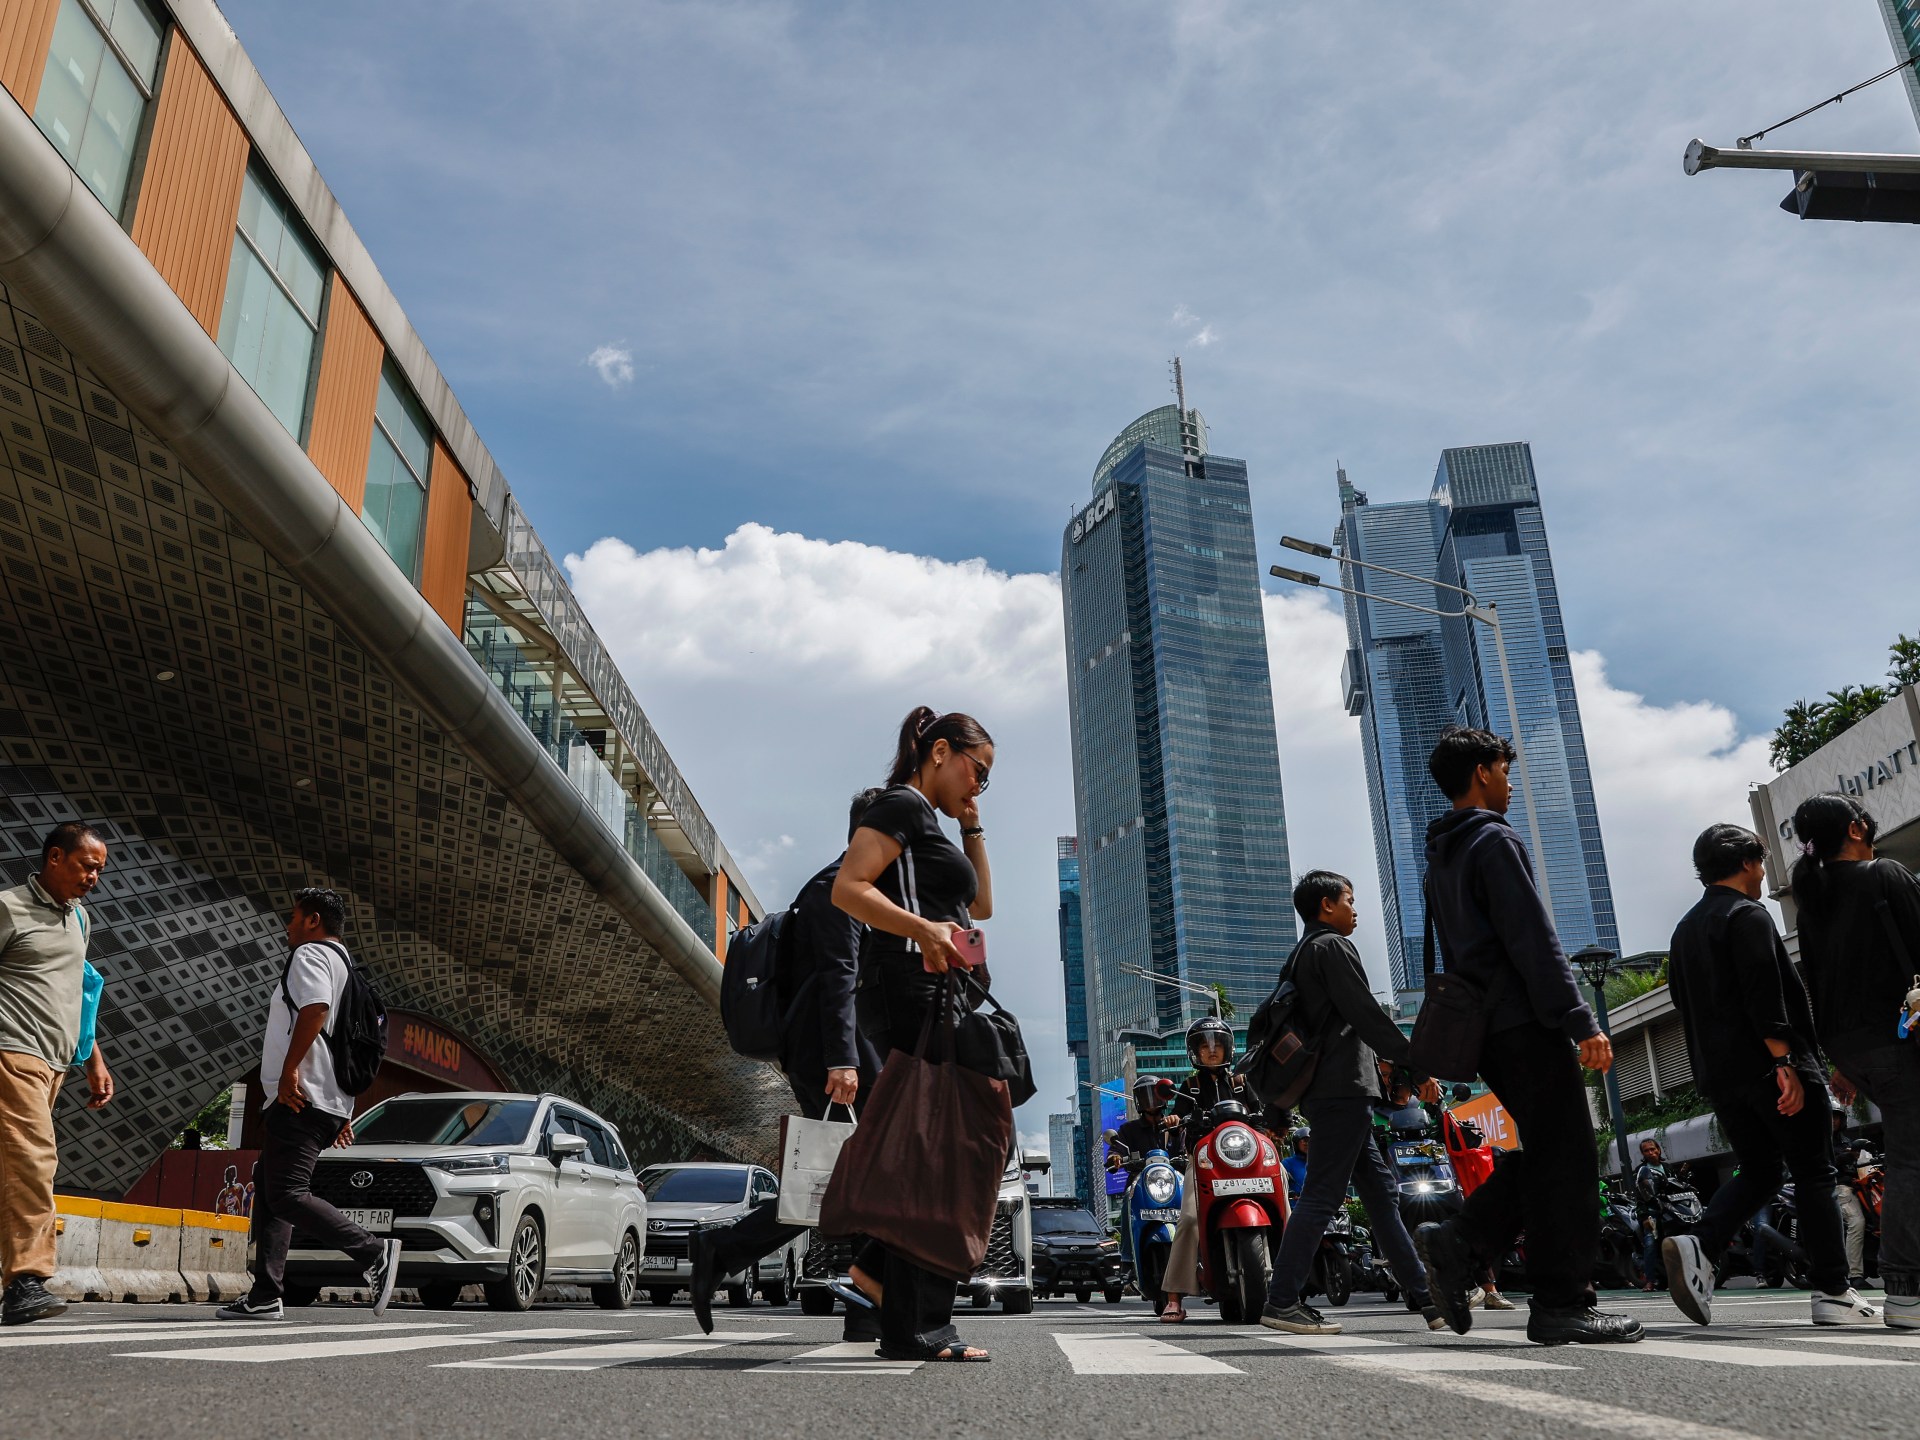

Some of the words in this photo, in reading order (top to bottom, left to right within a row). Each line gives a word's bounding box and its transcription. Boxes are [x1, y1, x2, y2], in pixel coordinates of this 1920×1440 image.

[1085, 489, 1114, 533] BCA
[1837, 740, 1918, 796] HYATT
[403, 1023, 461, 1072] #MAKSU
[1213, 1180, 1219, 1188] B
[370, 1210, 391, 1224] FAR
